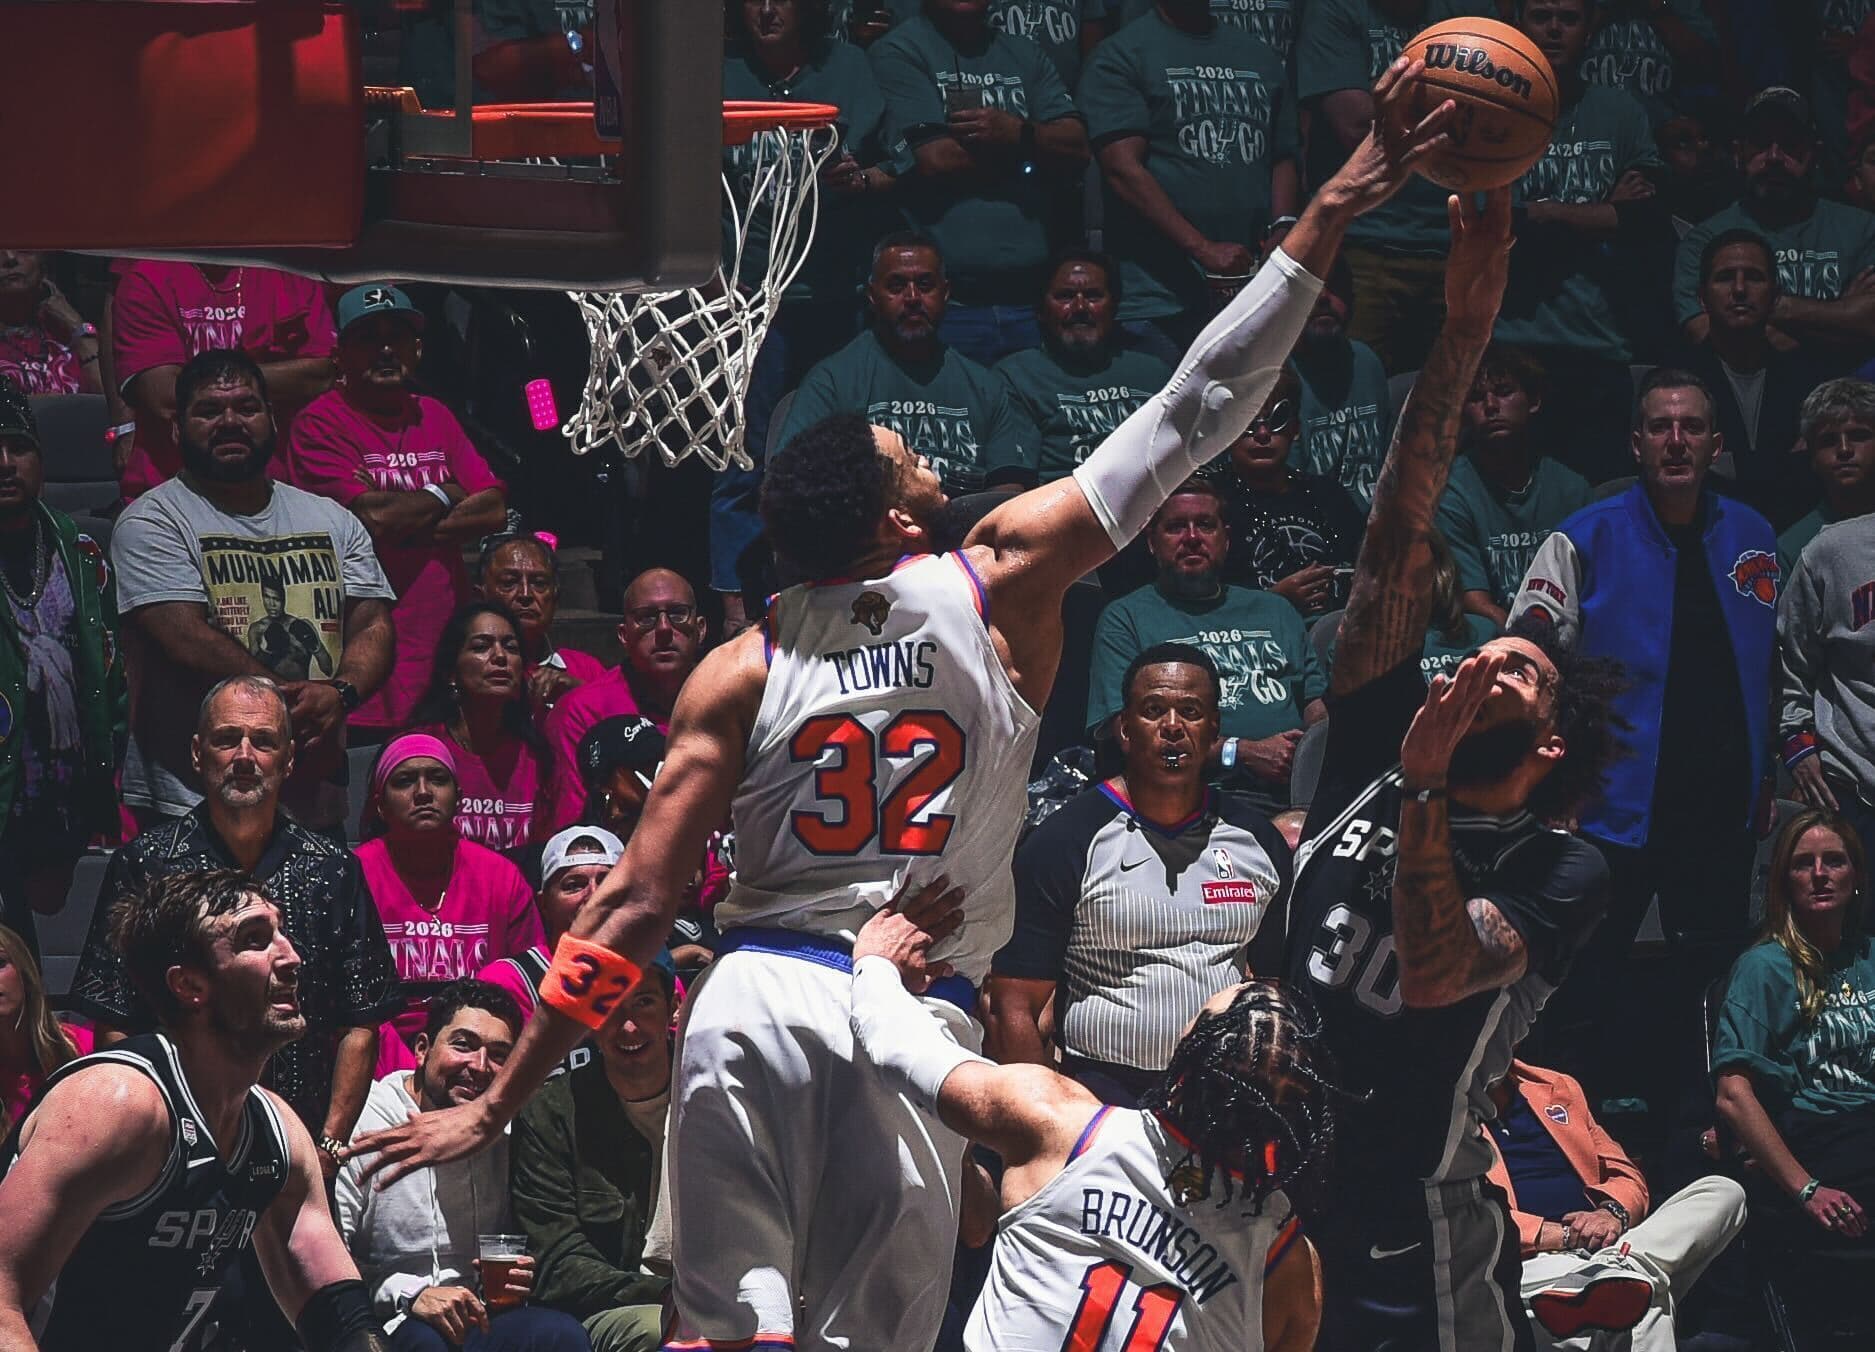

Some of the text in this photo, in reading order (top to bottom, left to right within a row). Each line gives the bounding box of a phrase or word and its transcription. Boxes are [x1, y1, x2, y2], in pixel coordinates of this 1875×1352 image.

[1196, 66, 1235, 80] 2026
[1424, 43, 1533, 101] Wilson
[1167, 79, 1272, 124] FINALS
[1178, 120, 1266, 166] GO GO
[891, 400, 936, 415] 2026
[1086, 386, 1130, 404] 2026
[206, 553, 338, 586] MUHAMMAD
[1198, 629, 1243, 644] 2026
[823, 641, 937, 694] TOWNS
[788, 708, 967, 857] 32
[461, 797, 504, 815] 2026
[1203, 885, 1256, 900] Emirates
[404, 920, 454, 938] 2026
[1306, 902, 1405, 1018] 30
[561, 953, 630, 1016] 32
[1080, 1188, 1238, 1305] BRUNSON
[169, 1287, 223, 1352] 7
[1060, 1258, 1188, 1352] 11
